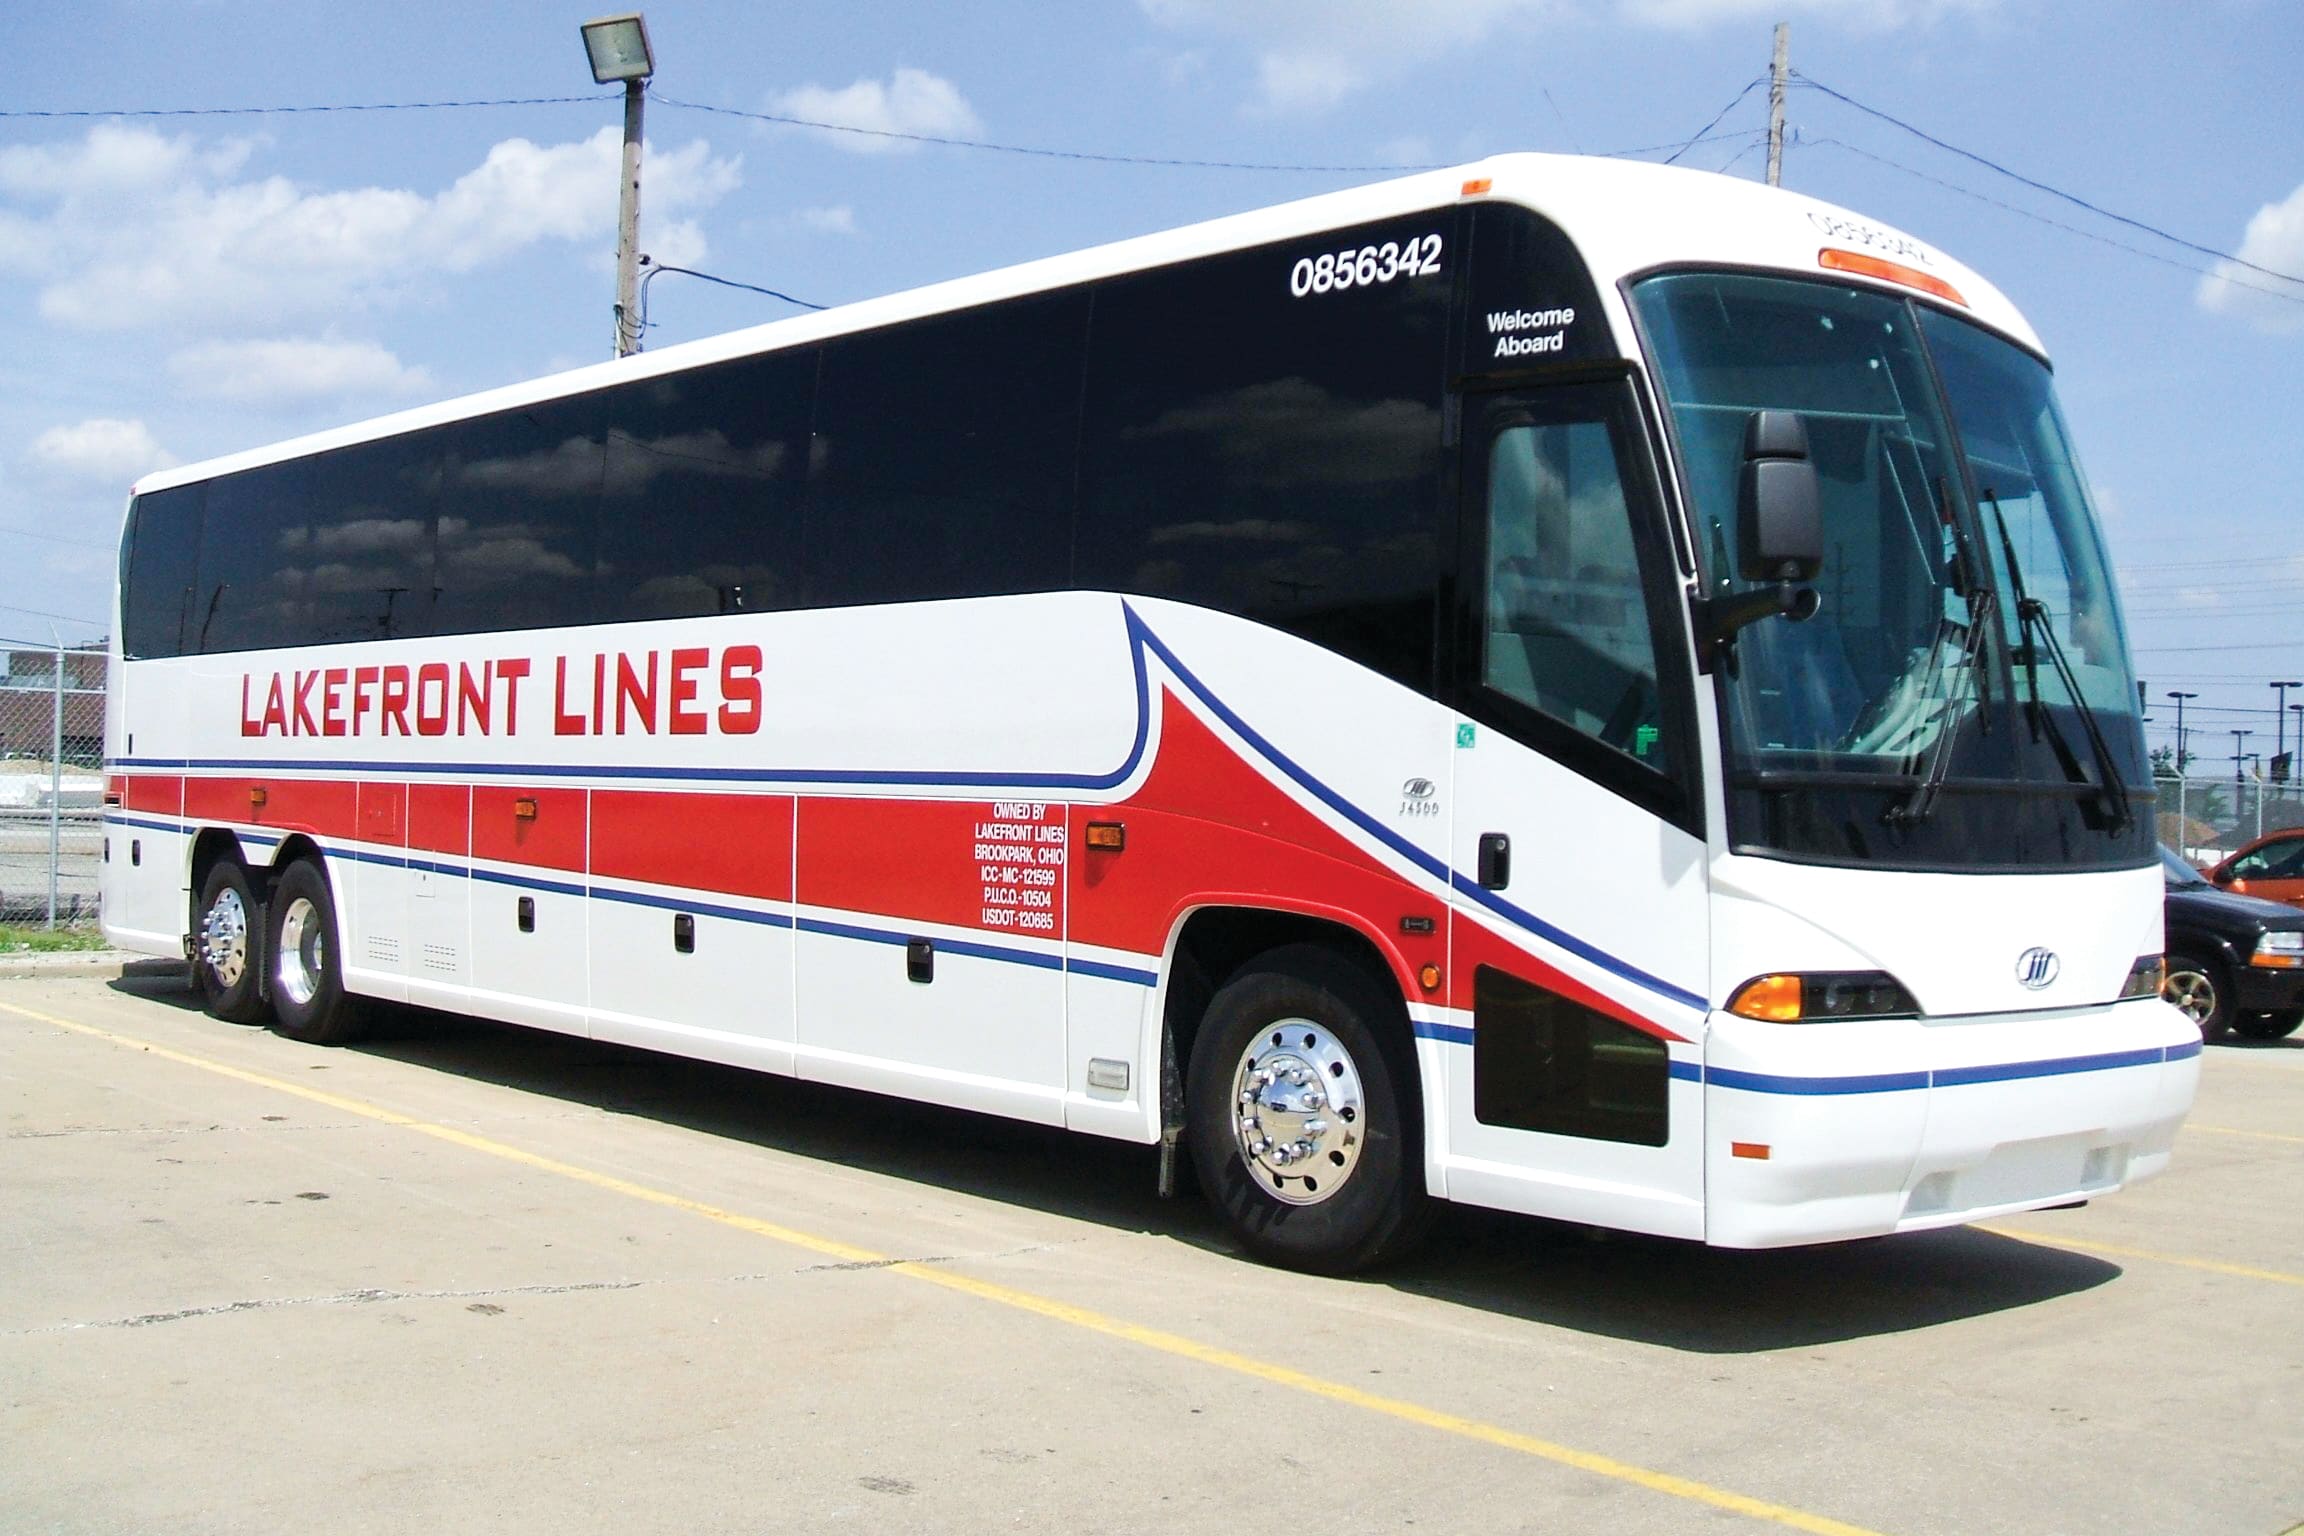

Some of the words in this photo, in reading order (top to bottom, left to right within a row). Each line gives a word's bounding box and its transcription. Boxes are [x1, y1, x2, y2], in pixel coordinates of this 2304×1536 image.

[1291, 234, 1443, 297] 0856342
[1487, 307, 1574, 333] Welcome
[1494, 331, 1563, 357] Aboard
[241, 657, 531, 737] LAKEFRONT
[554, 645, 762, 735] LINES
[993, 803, 1031, 819] OWNED
[1032, 804, 1046, 821] BY
[975, 822, 1033, 842] LAKEFRONT
[1034, 826, 1065, 843] LINES
[974, 844, 1036, 866] BROOKPARK,
[1038, 848, 1064, 865] OHIO
[981, 865, 1055, 886] ICC-MC-121599
[982, 907, 1053, 929] USDOT-120685
